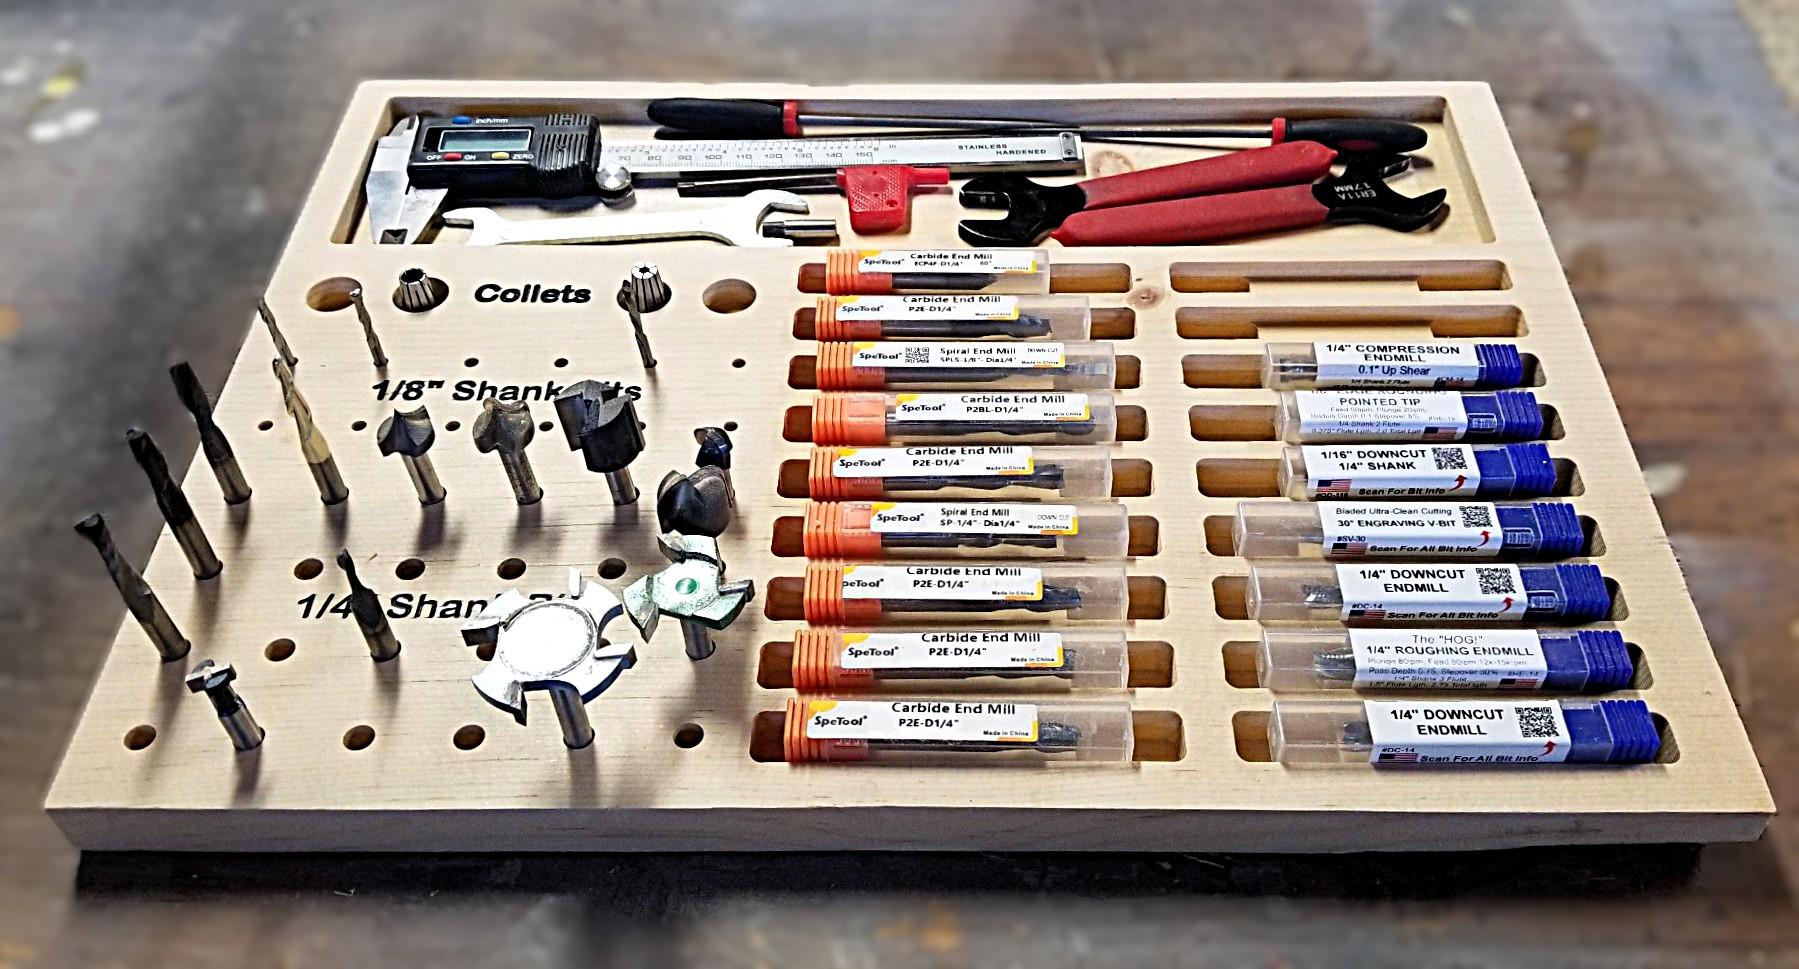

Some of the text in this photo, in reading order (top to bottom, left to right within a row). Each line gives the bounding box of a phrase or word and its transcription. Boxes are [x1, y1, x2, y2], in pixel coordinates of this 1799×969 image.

[475, 116, 509, 125] inch/mm
[1334, 182, 1371, 194] 17MM
[1338, 190, 1377, 200] ER11A
[474, 283, 592, 304] Collets
[940, 348, 1016, 356] Spiral End Mill
[1326, 344, 1460, 354] 1/4" COMPRESSION
[1364, 354, 1426, 362] ENDMILL
[1358, 364, 1430, 376] 0.1" Up Shear
[372, 380, 564, 402] 1/8" Shank
[1340, 398, 1420, 406] POINTED TIP
[906, 447, 1013, 456] Carbide End Mill
[1320, 450, 1426, 460] 1/16" DOWNCUT
[1338, 462, 1416, 470] 1/4" SHANK
[941, 508, 1010, 517] Spiral End Mill
[1420, 508, 1452, 516] Cutting
[1357, 520, 1456, 528] ENGRAVING V-BIT
[1370, 545, 1478, 553] Scan For All Bit Info
[906, 568, 1022, 576] Carbide End Mill
[1360, 570, 1466, 580] 1/4" DOWNCUT
[842, 580, 880, 588] peTool
[1384, 583, 1449, 593] ENDMILL
[297, 593, 502, 619] 1/4 Shan
[922, 632, 1041, 643] Carbide End Mill
[1412, 634, 1483, 644] The "HOG!"
[1366, 646, 1534, 656] 1/4" ROUGHING ENDMILL
[892, 702, 1016, 714] Carbide End Mill
[1390, 709, 1504, 720] 1/4" DOWNCUT
[1417, 724, 1488, 736] ENDMILL
